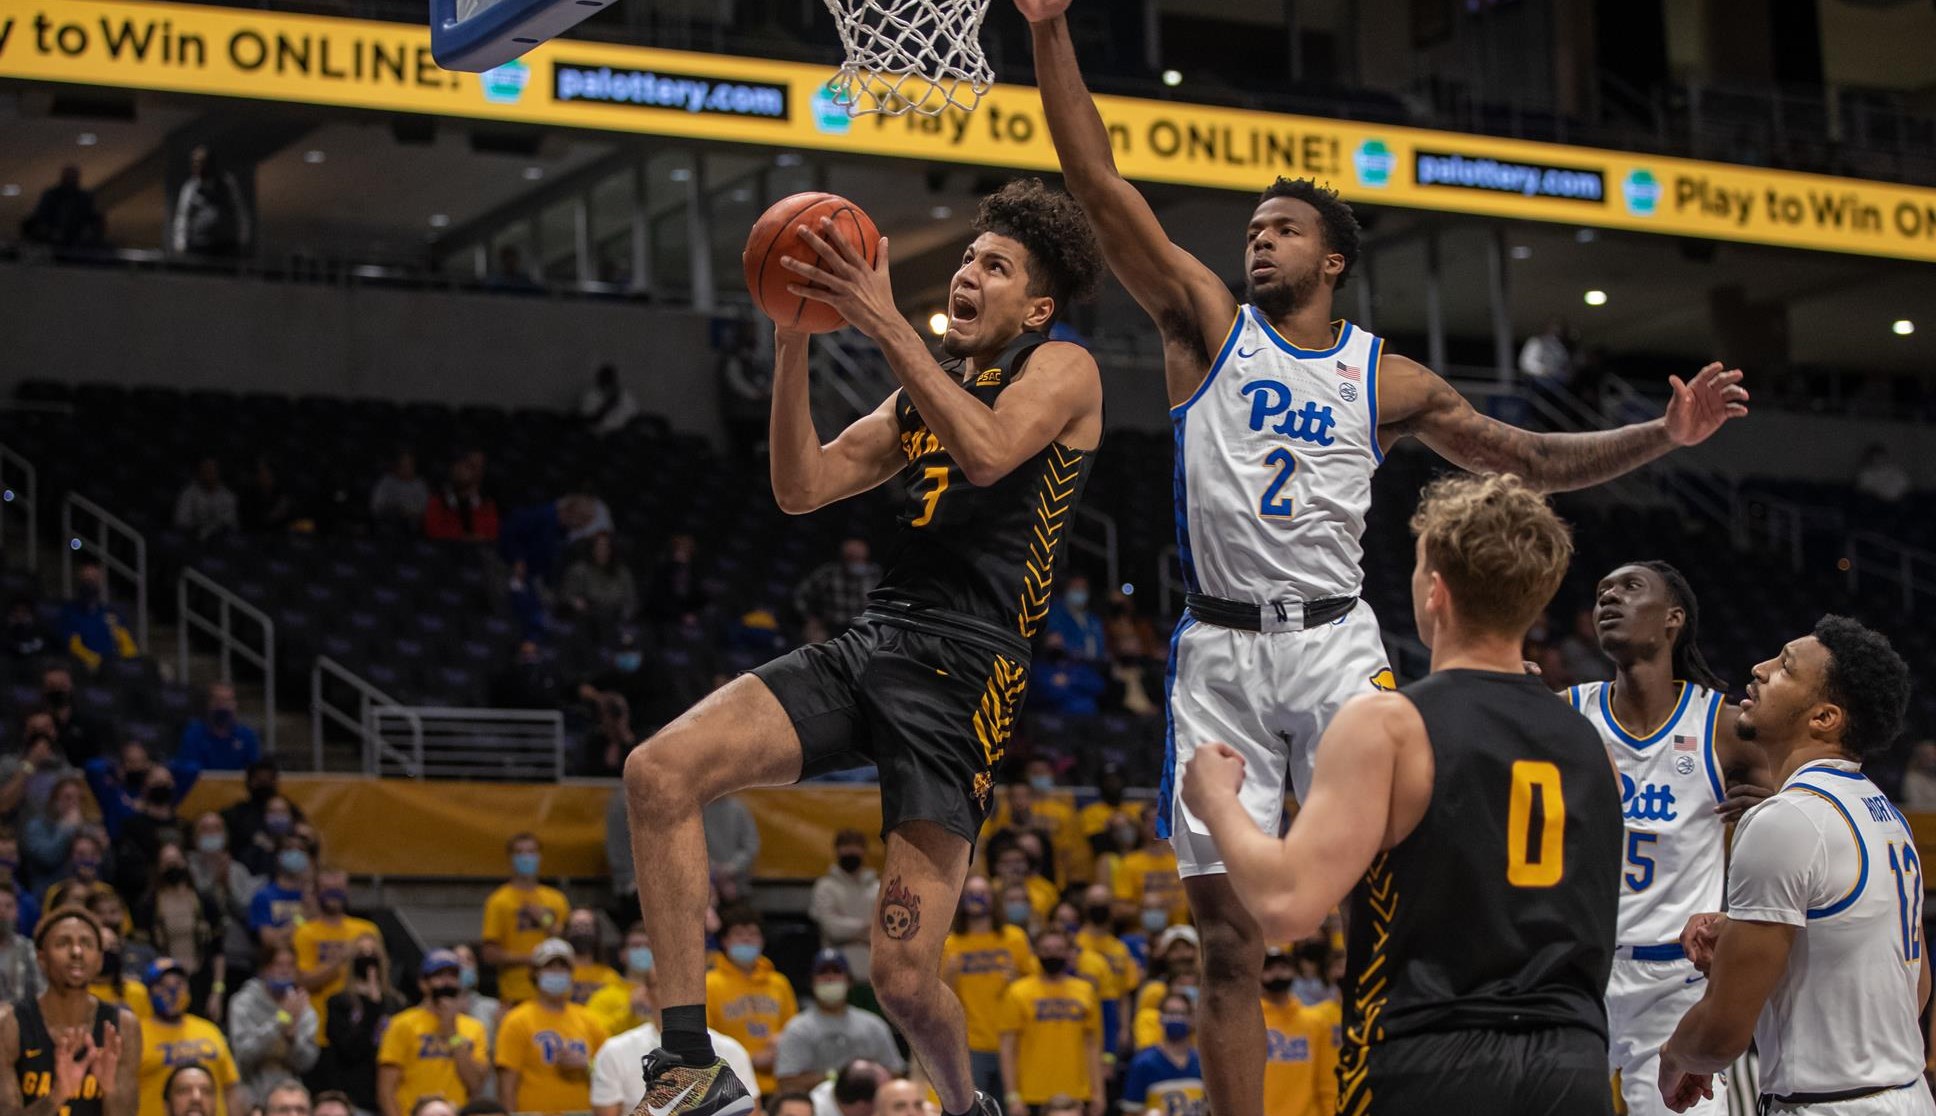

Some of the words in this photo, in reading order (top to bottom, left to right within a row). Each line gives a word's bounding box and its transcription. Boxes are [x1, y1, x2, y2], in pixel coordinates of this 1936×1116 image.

[34, 12, 88, 57] to
[100, 16, 207, 67] Win
[557, 66, 784, 116] palottery.com
[875, 89, 972, 146] Play
[987, 104, 1035, 143] to
[1149, 119, 1342, 175] ONLINE!
[1674, 175, 1754, 227] Play
[1766, 186, 1804, 225] to
[1809, 190, 1883, 232] Win
[1241, 380, 1336, 447] Pitt
[1258, 446, 1297, 520] 2
[1507, 760, 1565, 888] 0
[1861, 794, 1898, 823] HORT
[1624, 829, 1659, 894] 5
[1887, 839, 1921, 965] 12
